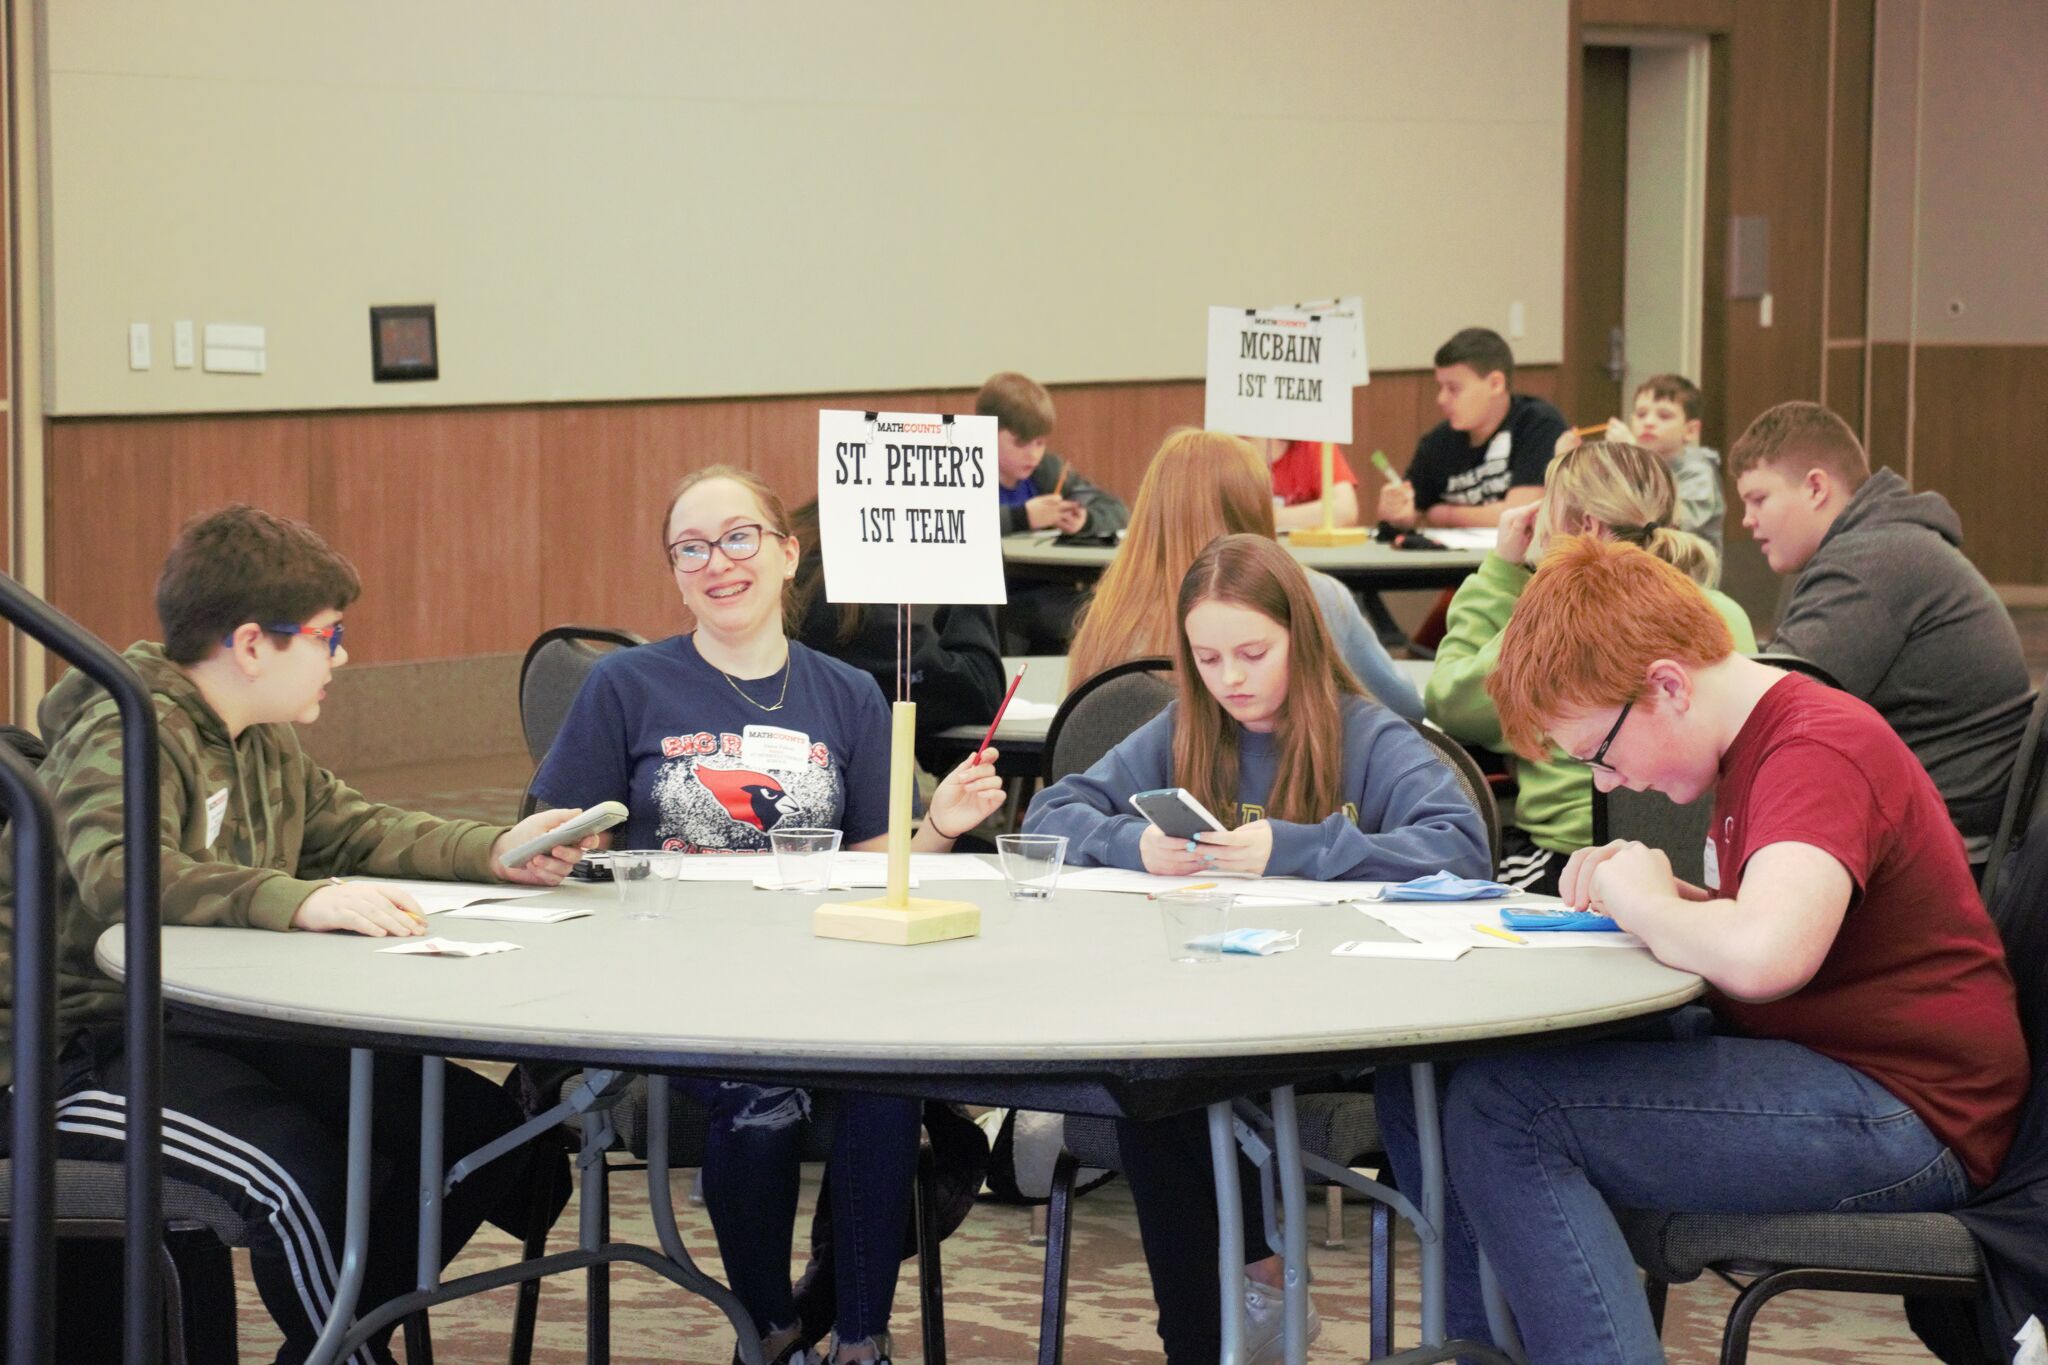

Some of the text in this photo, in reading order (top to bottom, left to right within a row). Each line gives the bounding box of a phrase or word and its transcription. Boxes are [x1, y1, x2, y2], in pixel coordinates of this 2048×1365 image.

[1240, 331, 1321, 364] MCBAIN
[1237, 373, 1323, 402] 1ST TEAM
[877, 422, 942, 434] MATHCOUNTS
[836, 442, 985, 488] ST. PETER'S
[860, 507, 967, 544] 1ST TEAM
[661, 731, 717, 760] BIG
